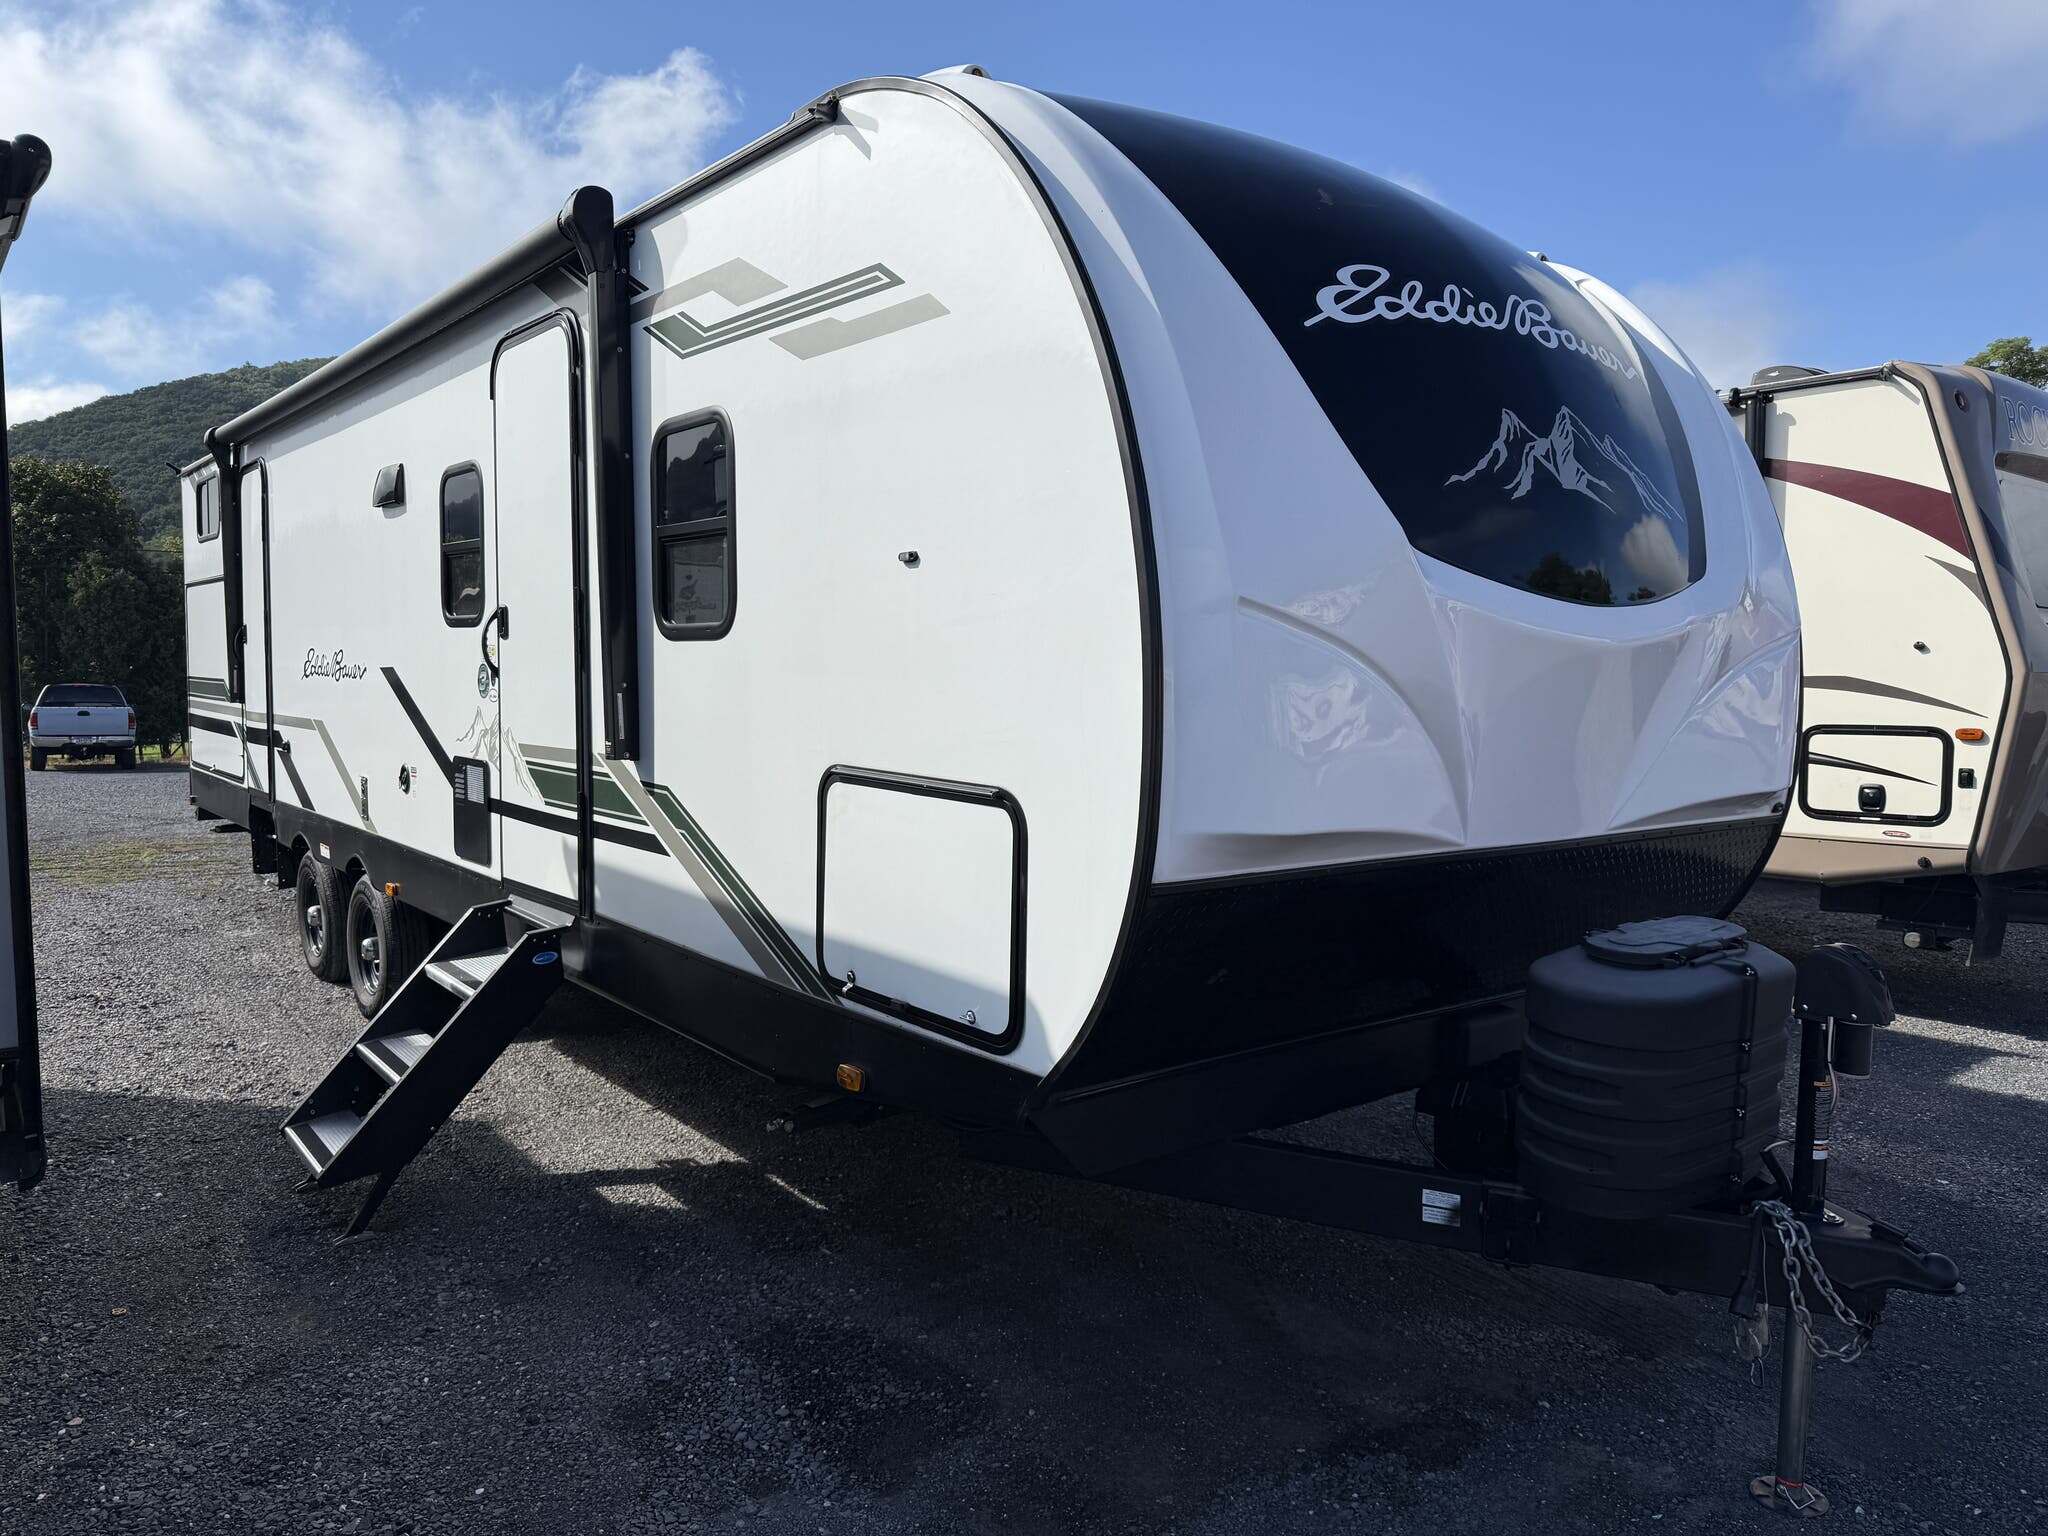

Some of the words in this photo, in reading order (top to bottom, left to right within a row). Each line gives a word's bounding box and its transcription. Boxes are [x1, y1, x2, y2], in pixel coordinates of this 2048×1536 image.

[1303, 264, 1509, 330] Eddie
[1508, 294, 1638, 379] Bauer
[1999, 395, 2048, 449] ROC
[301, 648, 333, 678] Eddie
[332, 649, 367, 682] Bauer
